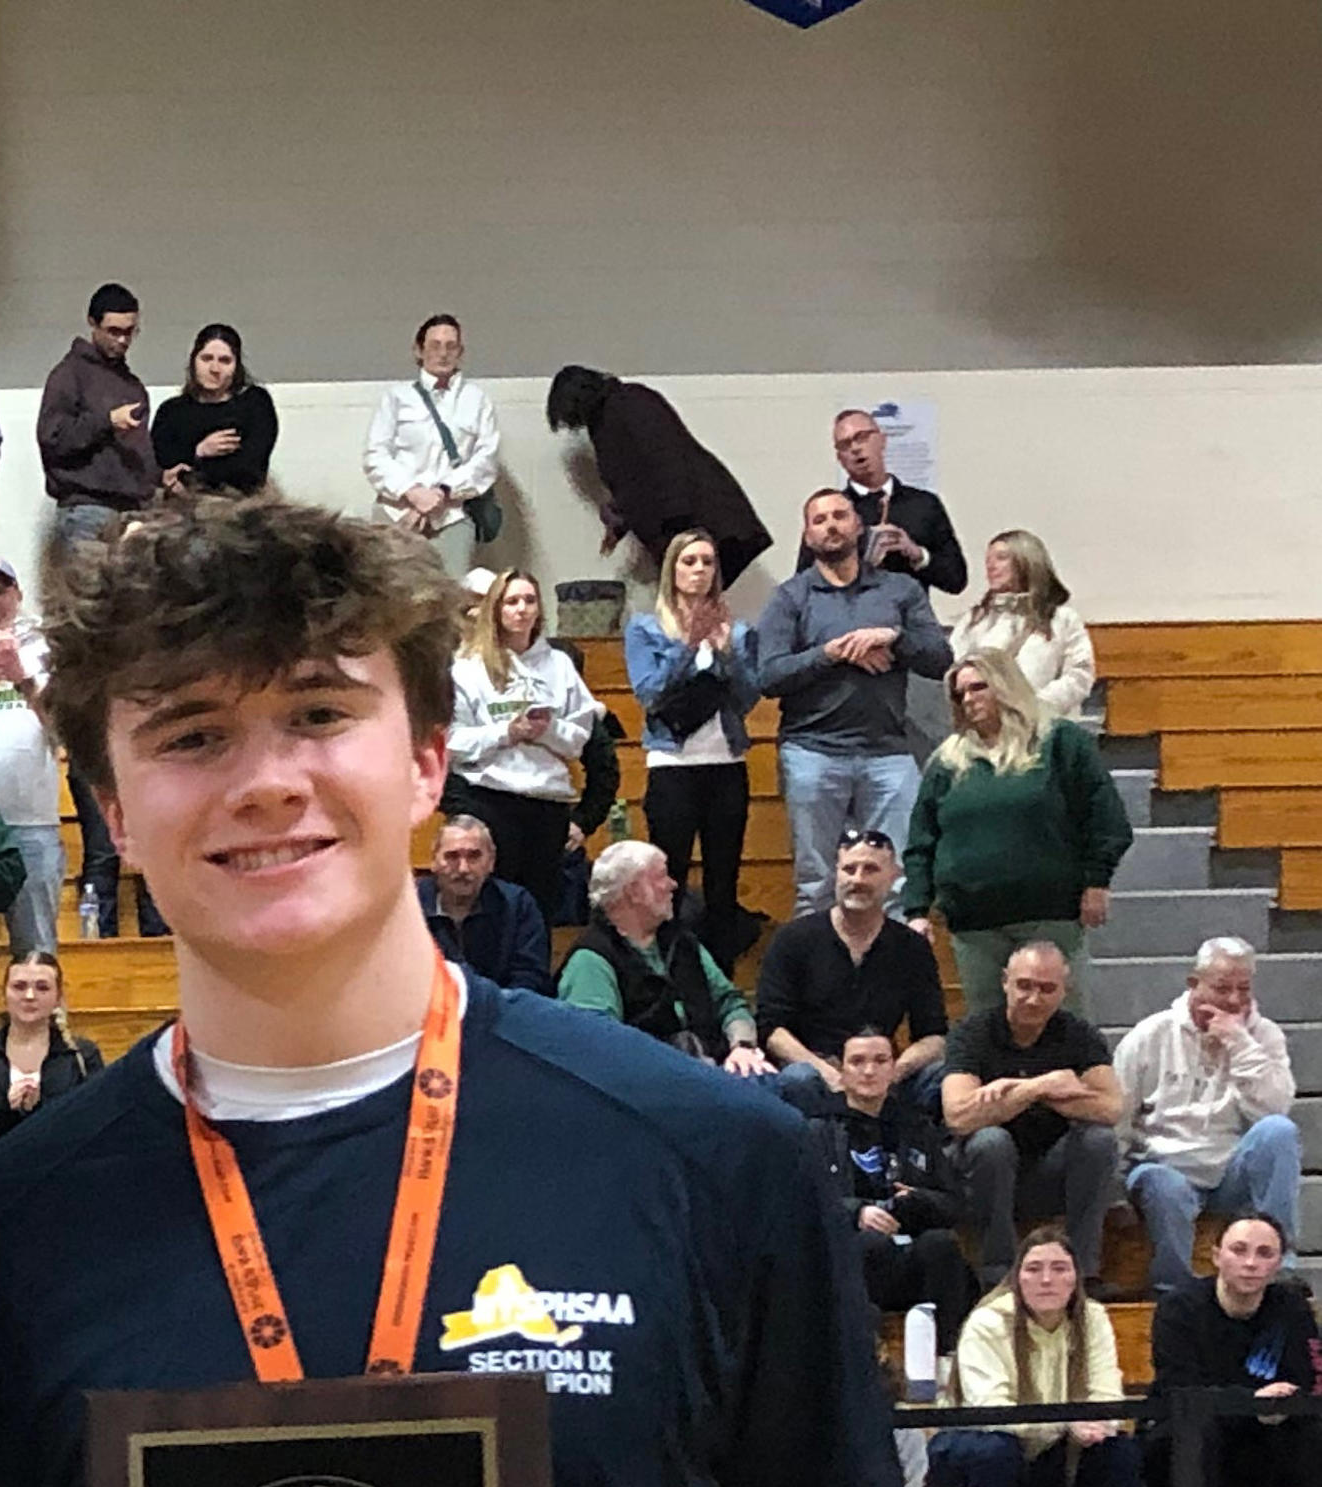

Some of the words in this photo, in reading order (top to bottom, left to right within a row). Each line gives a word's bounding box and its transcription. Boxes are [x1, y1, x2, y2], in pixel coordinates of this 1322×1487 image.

[469, 1349, 584, 1372] SECTION
[588, 1350, 613, 1372] IX
[546, 1372, 613, 1394] PION
